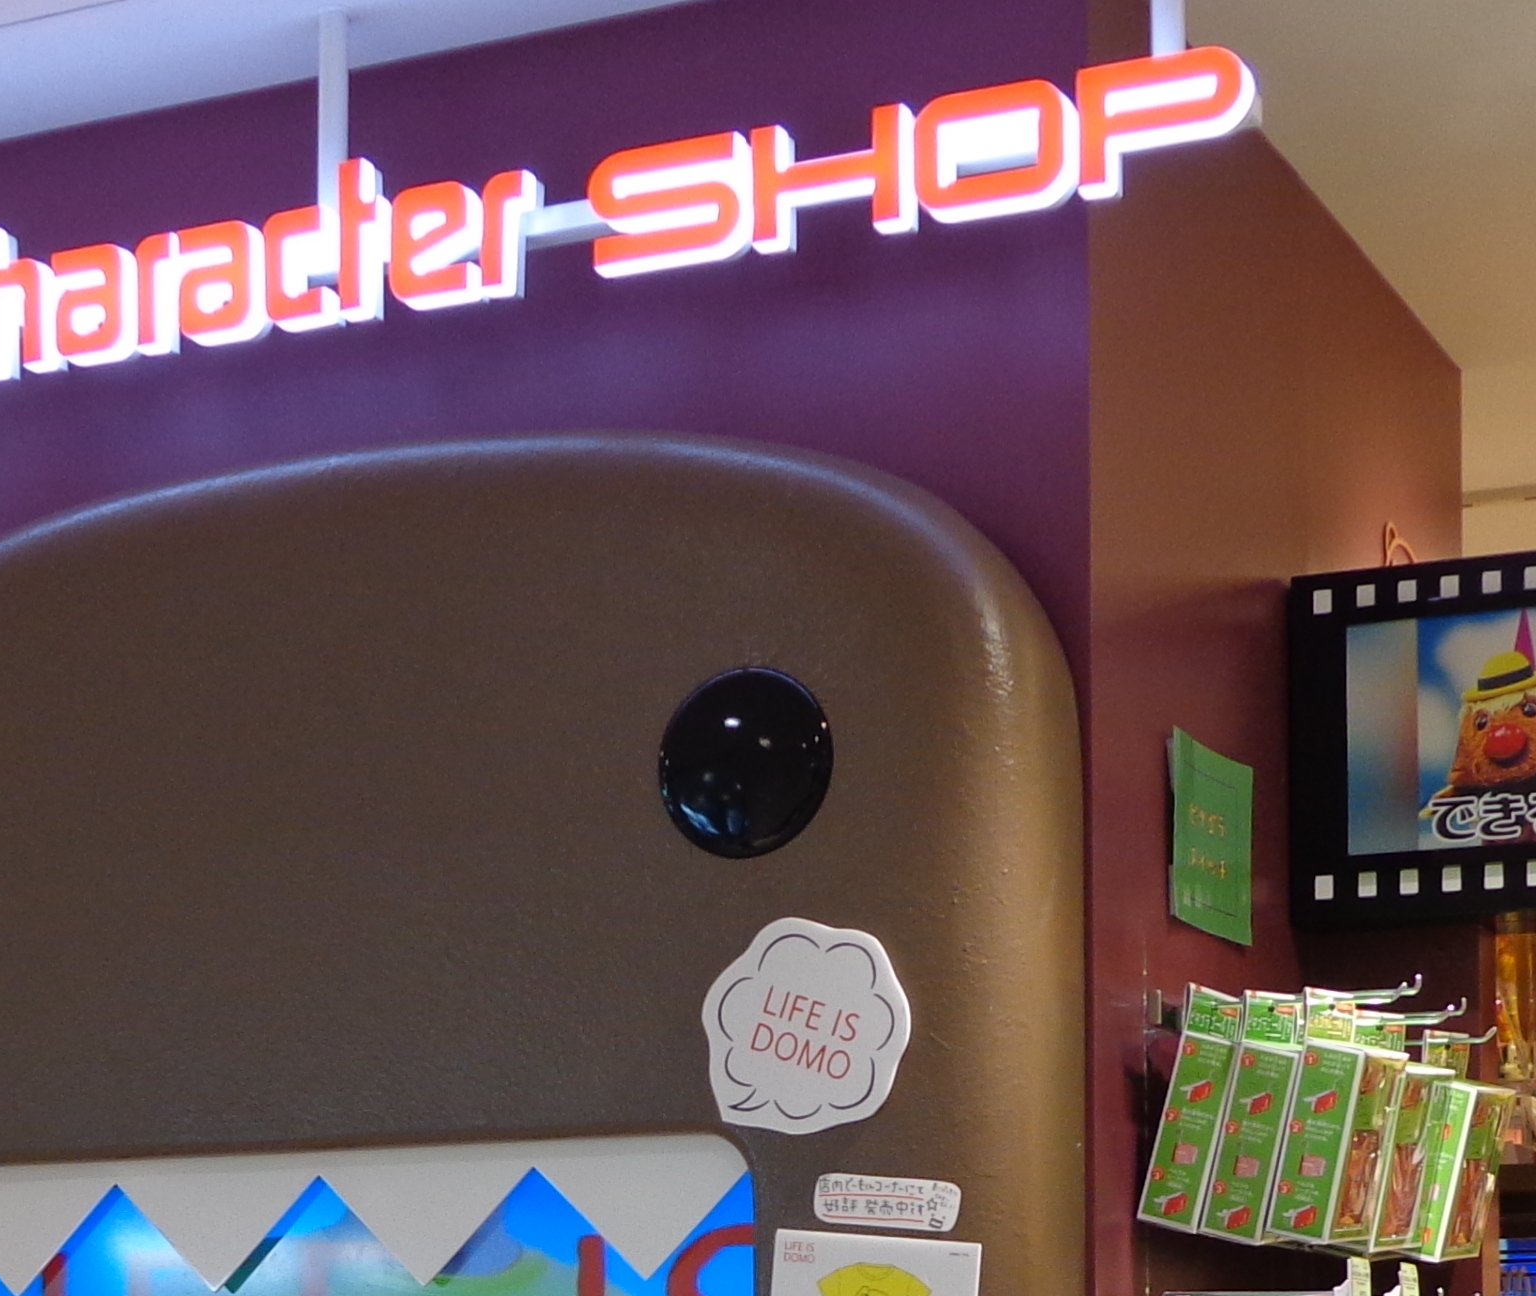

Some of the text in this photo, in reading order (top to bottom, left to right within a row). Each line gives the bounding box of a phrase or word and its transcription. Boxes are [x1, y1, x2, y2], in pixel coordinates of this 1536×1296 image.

[584, 44, 1264, 278] SHOP
[762, 985, 861, 1042] LIFE IS
[750, 1022, 852, 1080] DOMO
[783, 1241, 815, 1252] LIFE IS
[783, 1251, 816, 1264] DOMO
